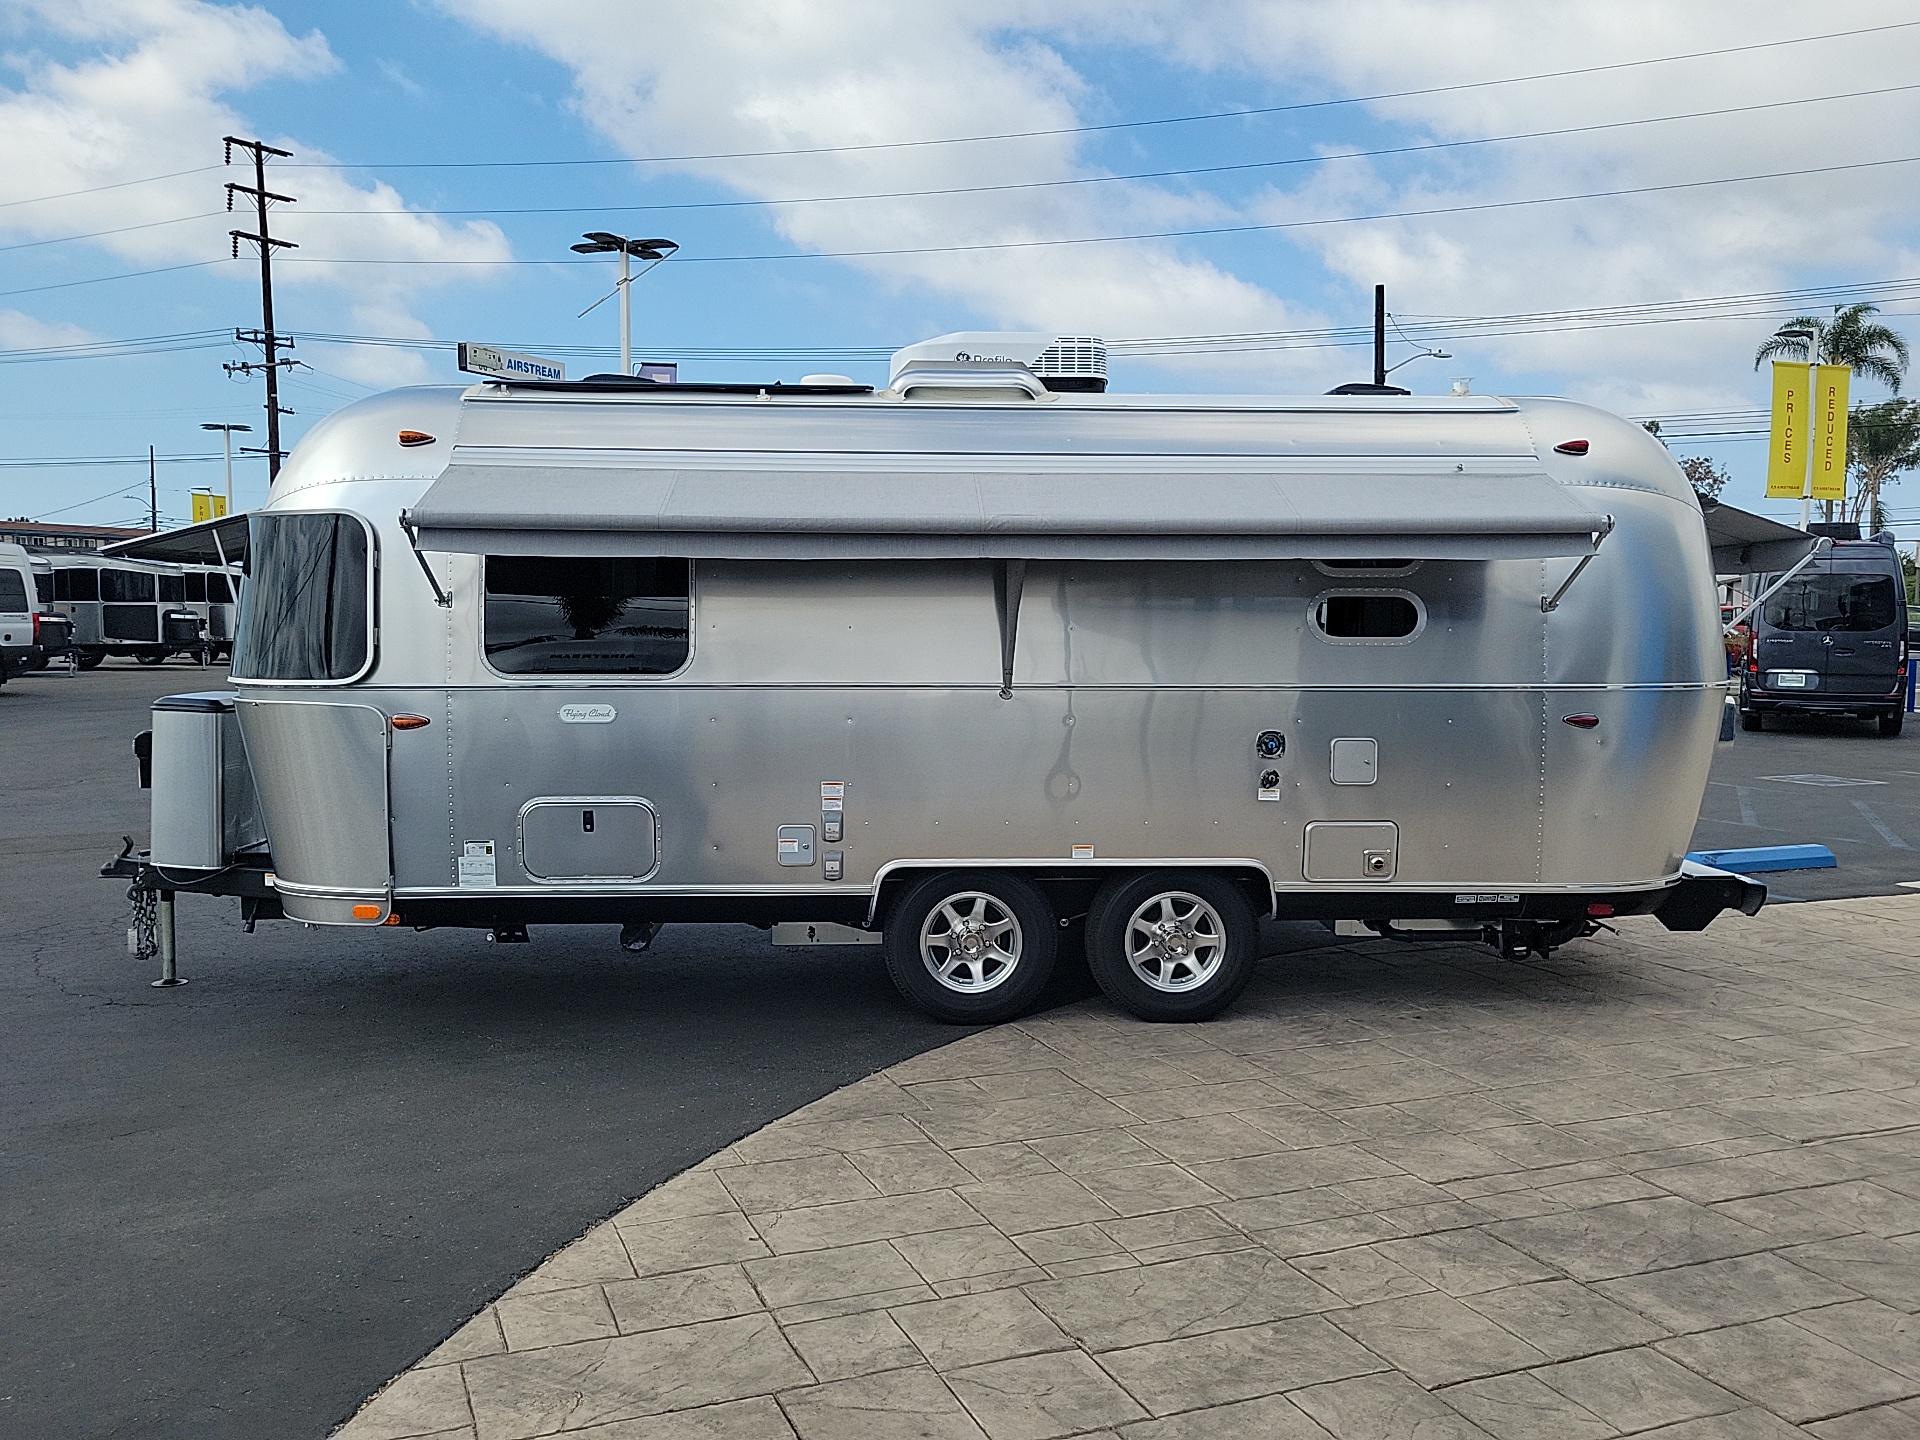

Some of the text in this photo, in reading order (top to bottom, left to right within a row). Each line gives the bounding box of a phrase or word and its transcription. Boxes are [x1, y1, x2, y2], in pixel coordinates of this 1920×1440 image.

[506, 358, 561, 380] AIRSTREAM
[1783, 389, 1794, 464] PRICES
[1824, 386, 1836, 471] REDUCED
[563, 708, 612, 720] Flying Cloud
